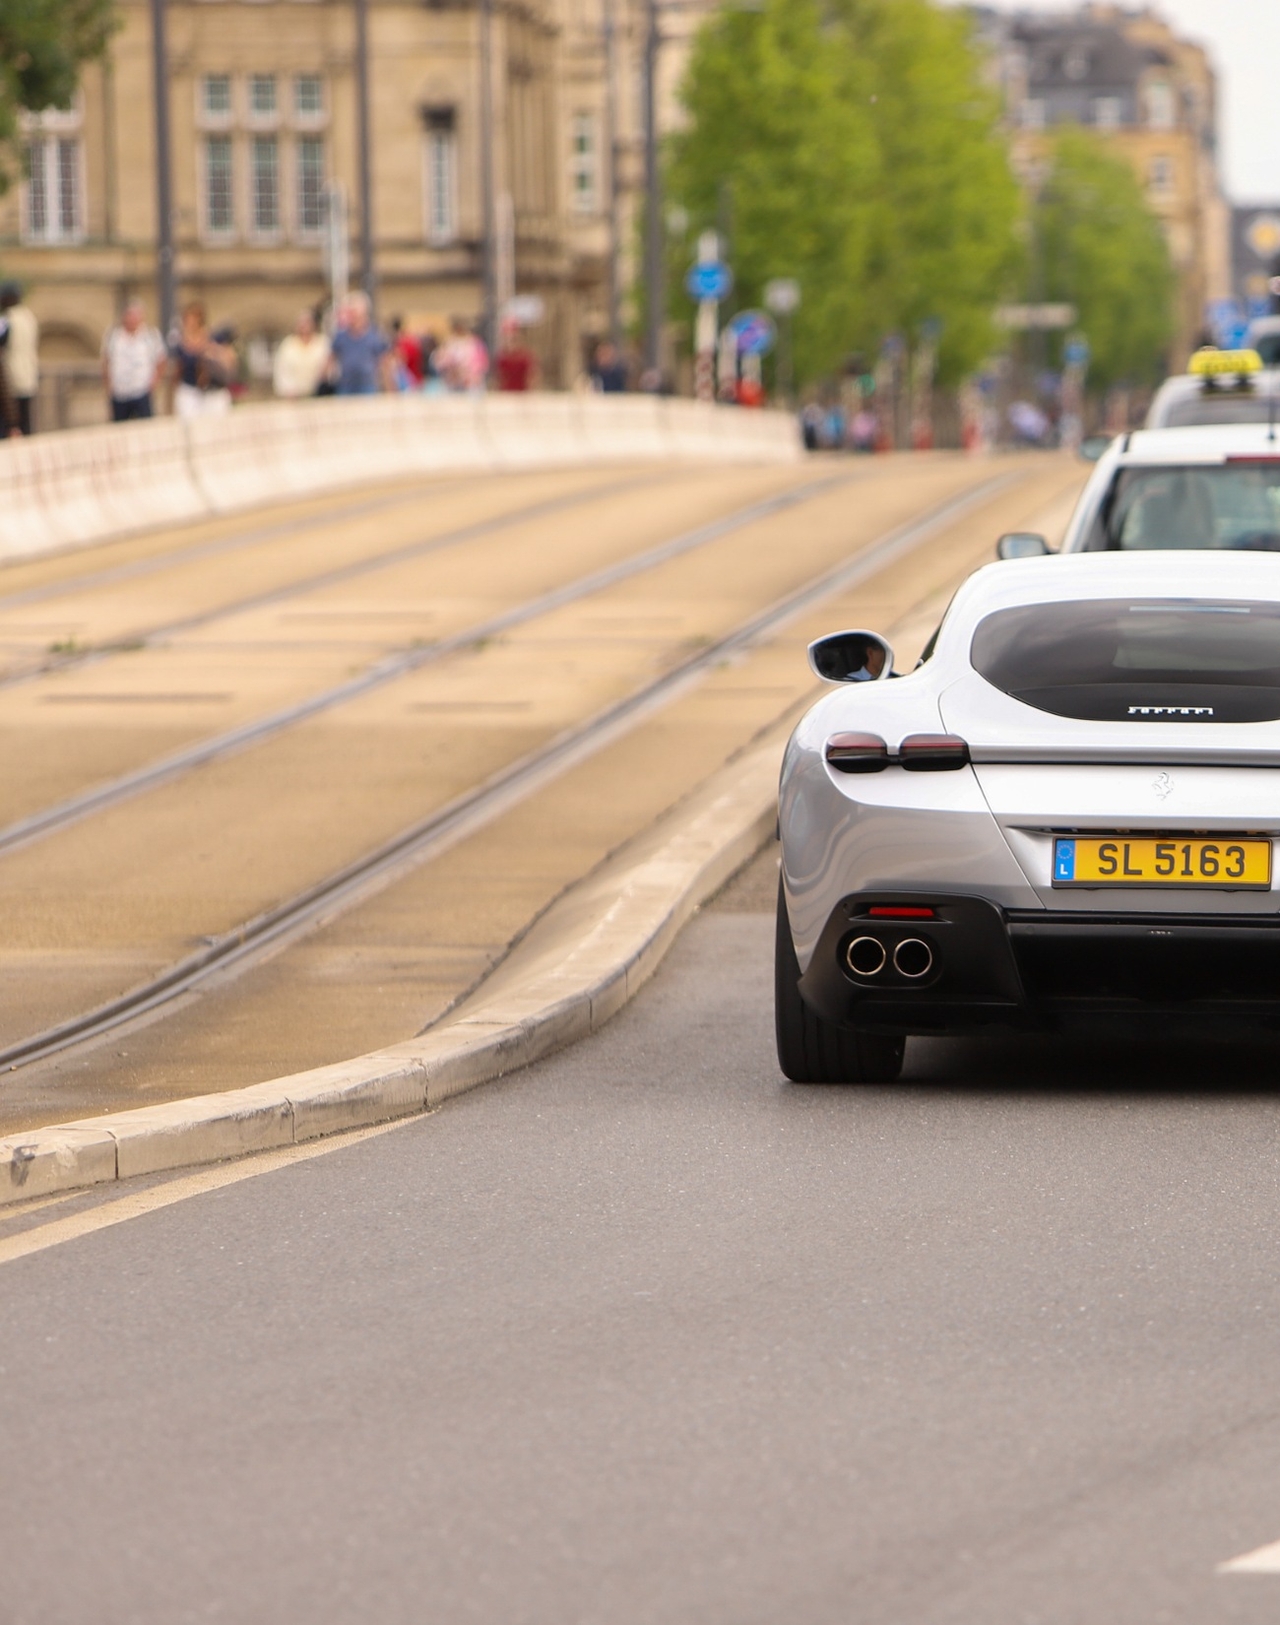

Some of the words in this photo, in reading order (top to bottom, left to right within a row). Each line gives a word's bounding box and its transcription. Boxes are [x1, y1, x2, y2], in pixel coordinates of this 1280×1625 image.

[1060, 864, 1069, 875] L
[1098, 843, 1143, 876] SL
[1155, 843, 1246, 878] 5163
